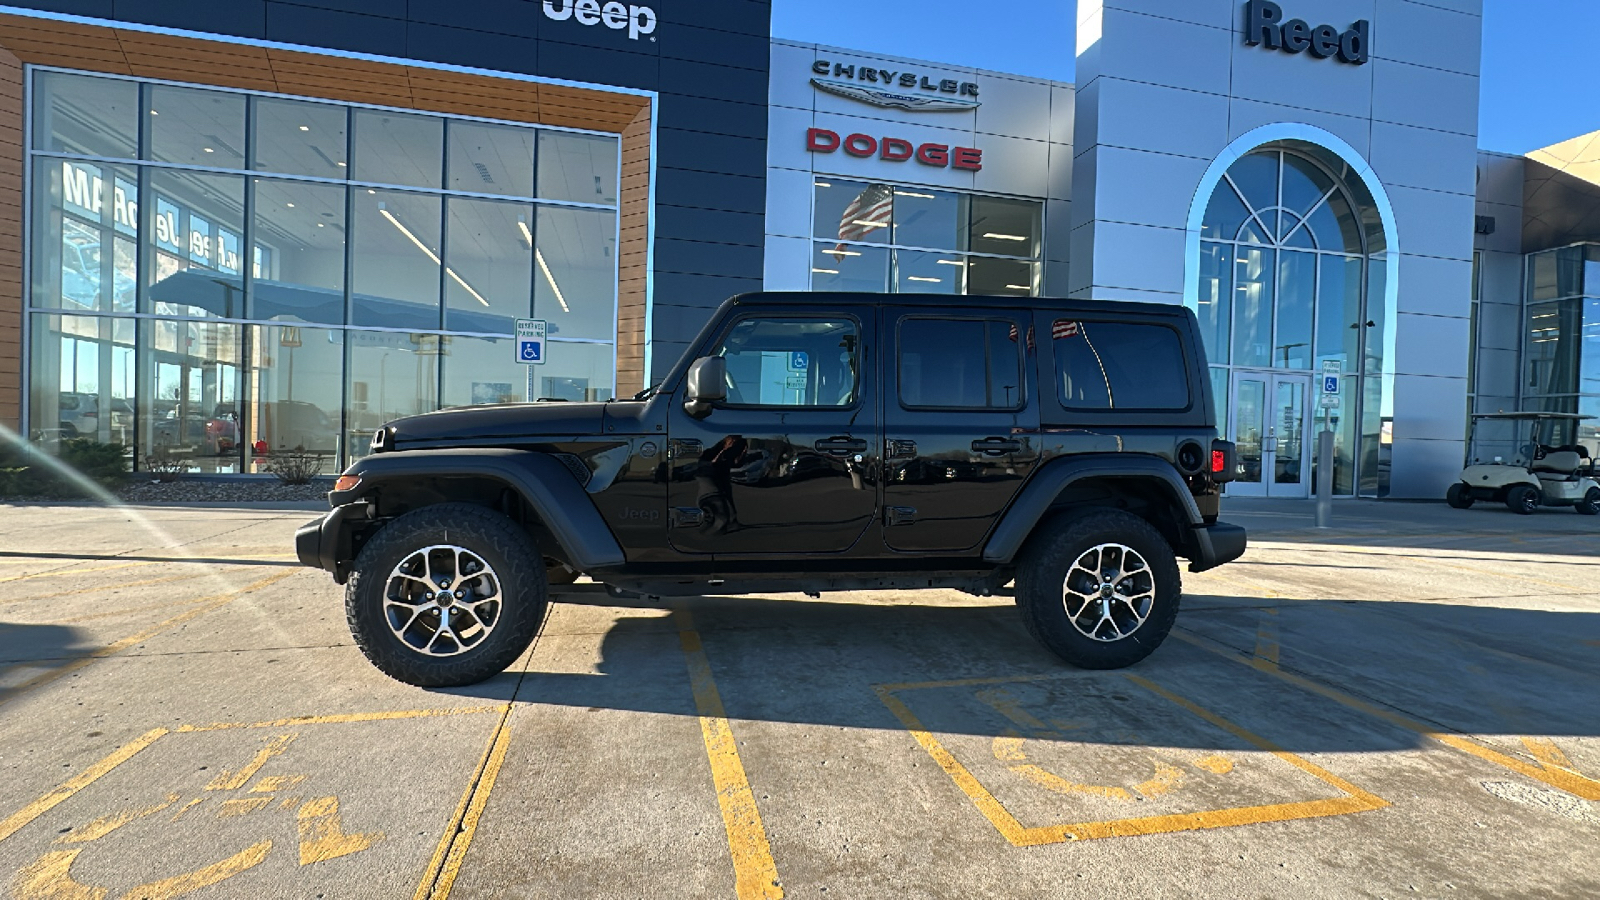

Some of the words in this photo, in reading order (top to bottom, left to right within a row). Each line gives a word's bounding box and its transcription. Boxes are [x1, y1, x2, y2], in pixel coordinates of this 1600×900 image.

[542, 0, 657, 40] Jeep
[1245, 0, 1369, 65] Reed
[812, 60, 980, 96] CHRYSLER
[807, 127, 983, 172] DODGE
[618, 506, 659, 521] Jeep
